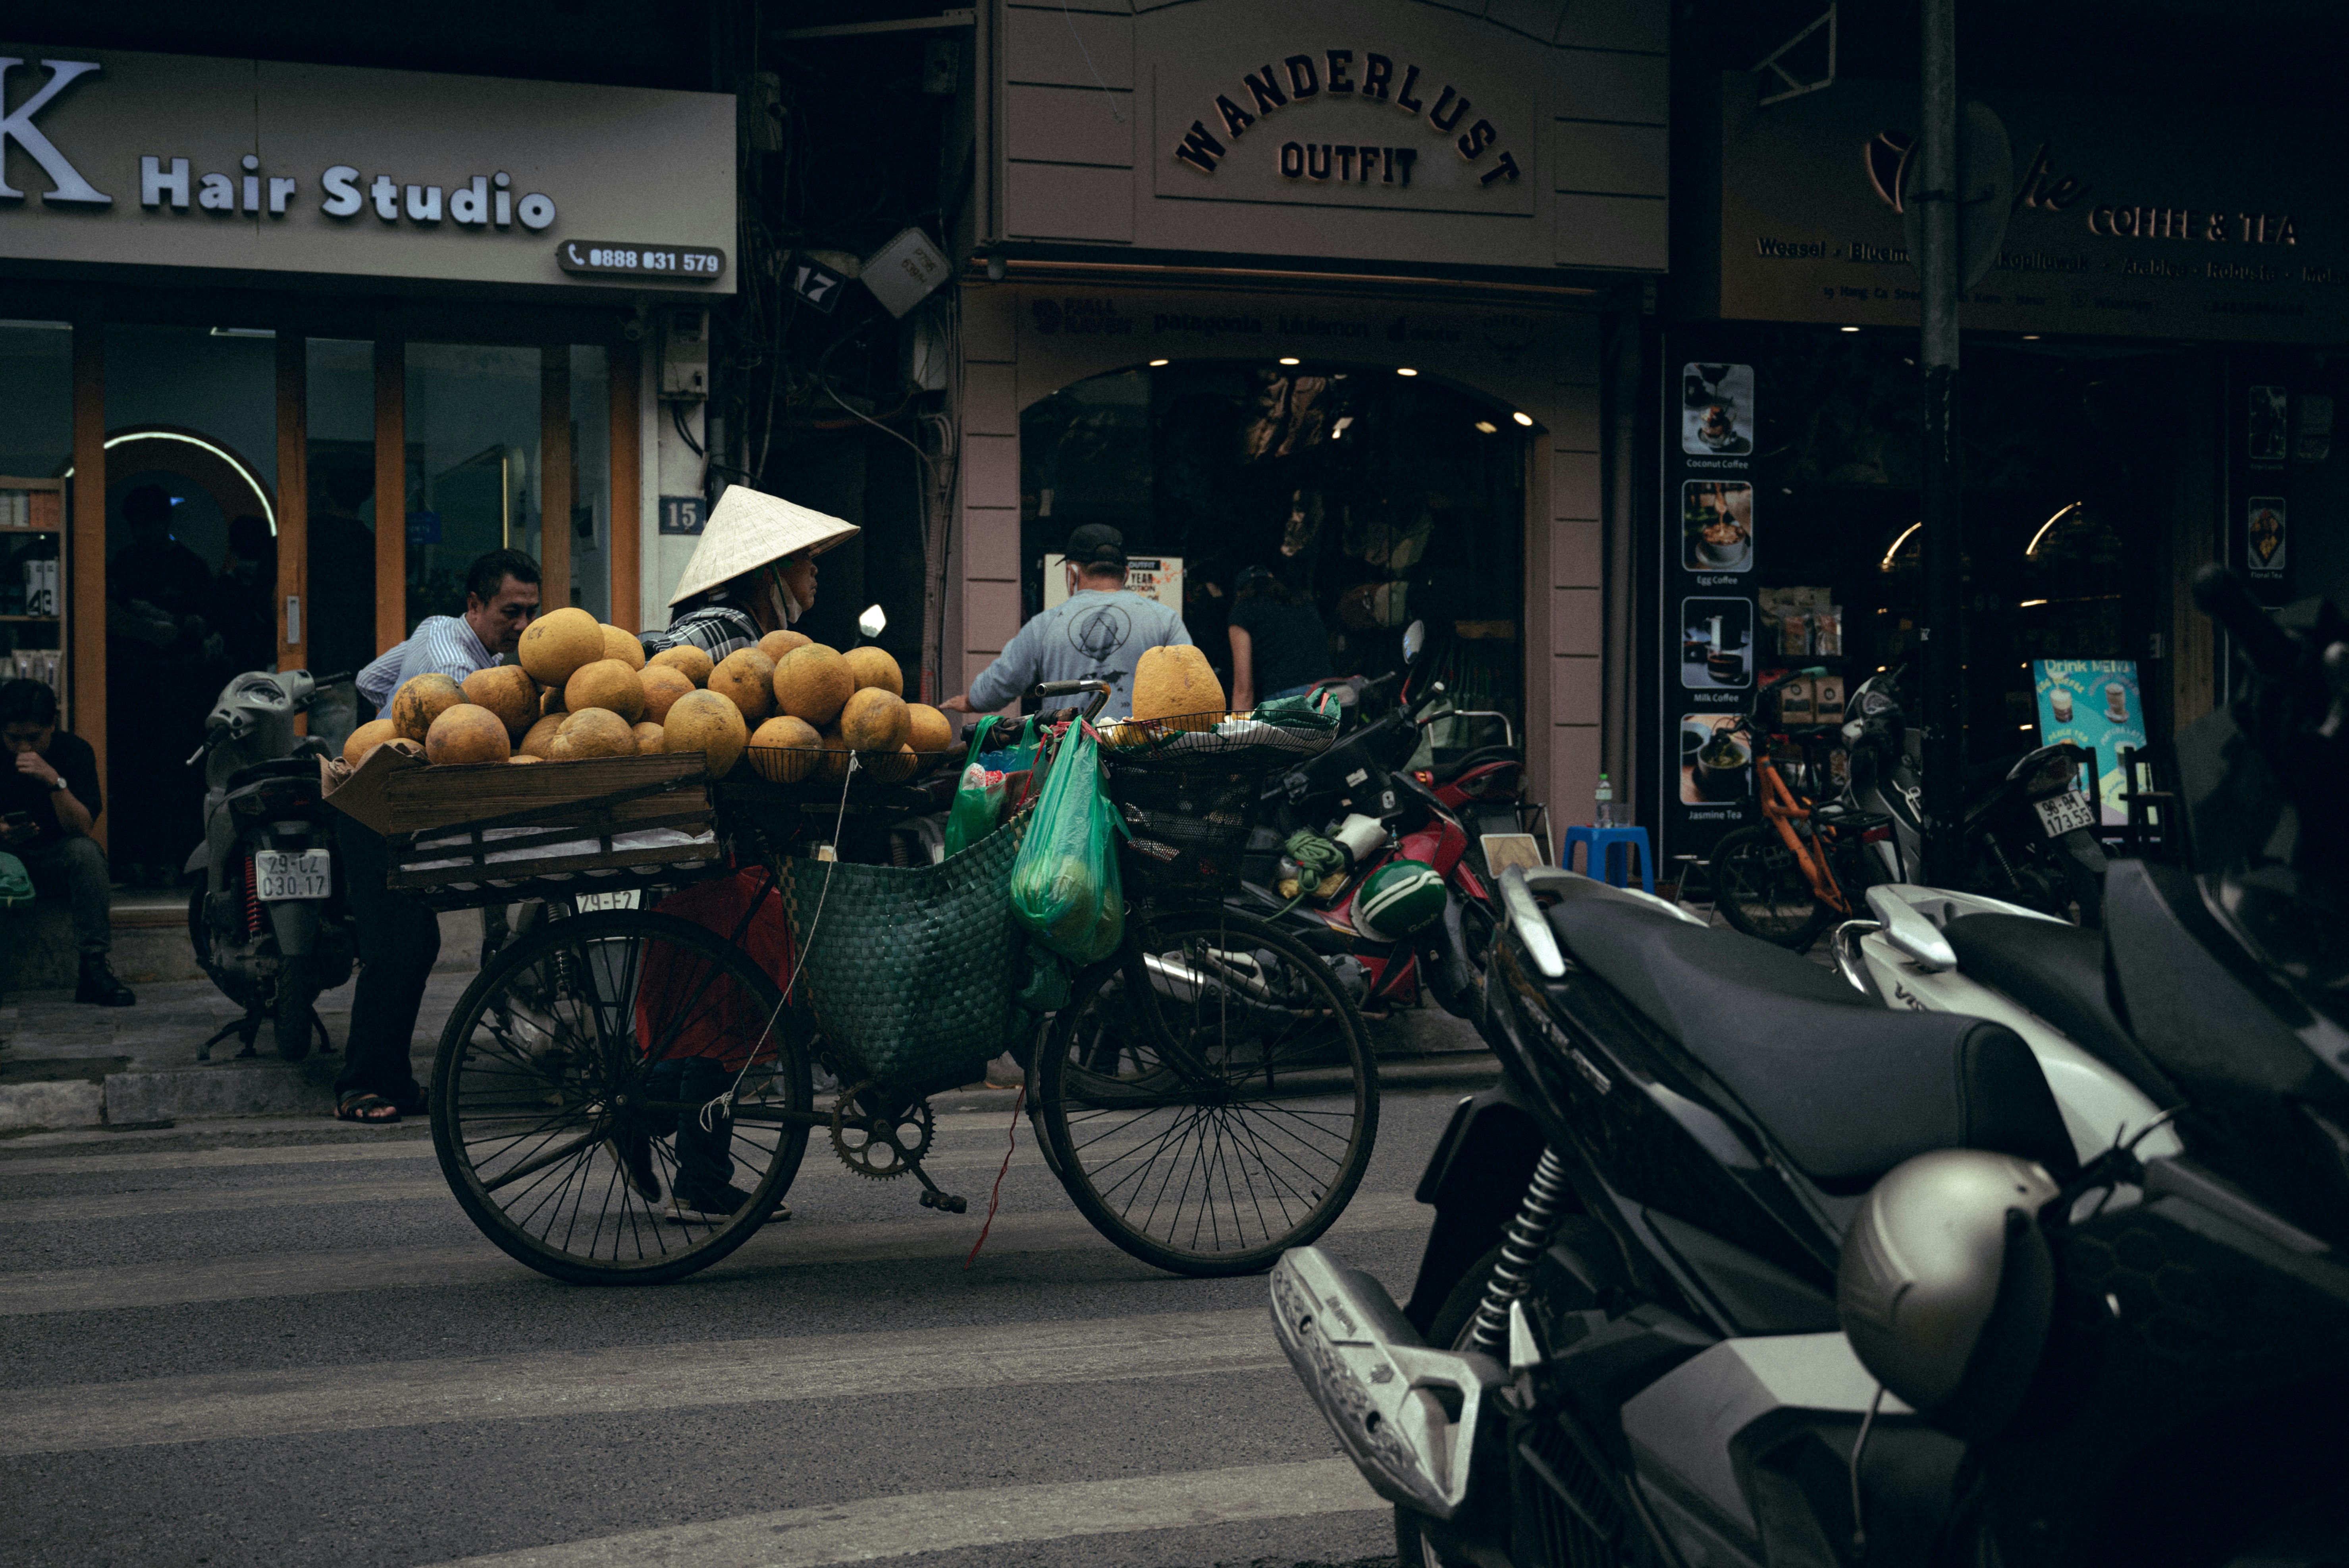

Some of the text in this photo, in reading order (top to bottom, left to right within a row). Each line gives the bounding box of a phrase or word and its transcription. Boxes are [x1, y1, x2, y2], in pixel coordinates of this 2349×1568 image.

[0, 57, 112, 203] K
[1175, 50, 1520, 186] WANDERLUST
[1281, 142, 1417, 186] OUTFIT
[140, 153, 556, 230] Hair Studio
[2087, 204, 2199, 239] COFFEE
[2205, 213, 2228, 241] &
[2239, 212, 2296, 245] TEA
[590, 248, 719, 273] 0888 031 579
[1757, 238, 1825, 258] Weasel
[793, 265, 838, 303] 17
[1154, 314, 1262, 337] patagonia
[1278, 315, 1369, 339] lululemon
[1686, 458, 1749, 469] Coconut Coffee
[669, 502, 697, 527] 15
[1132, 573, 1153, 583] YEAR
[1697, 575, 1738, 586] Egg Coffee
[2045, 659, 2087, 672] Drink
[1694, 693, 1739, 703] Milk Coffee
[1688, 809, 1742, 820] Jasmine Tea
[263, 876, 325, 896] 030.17
